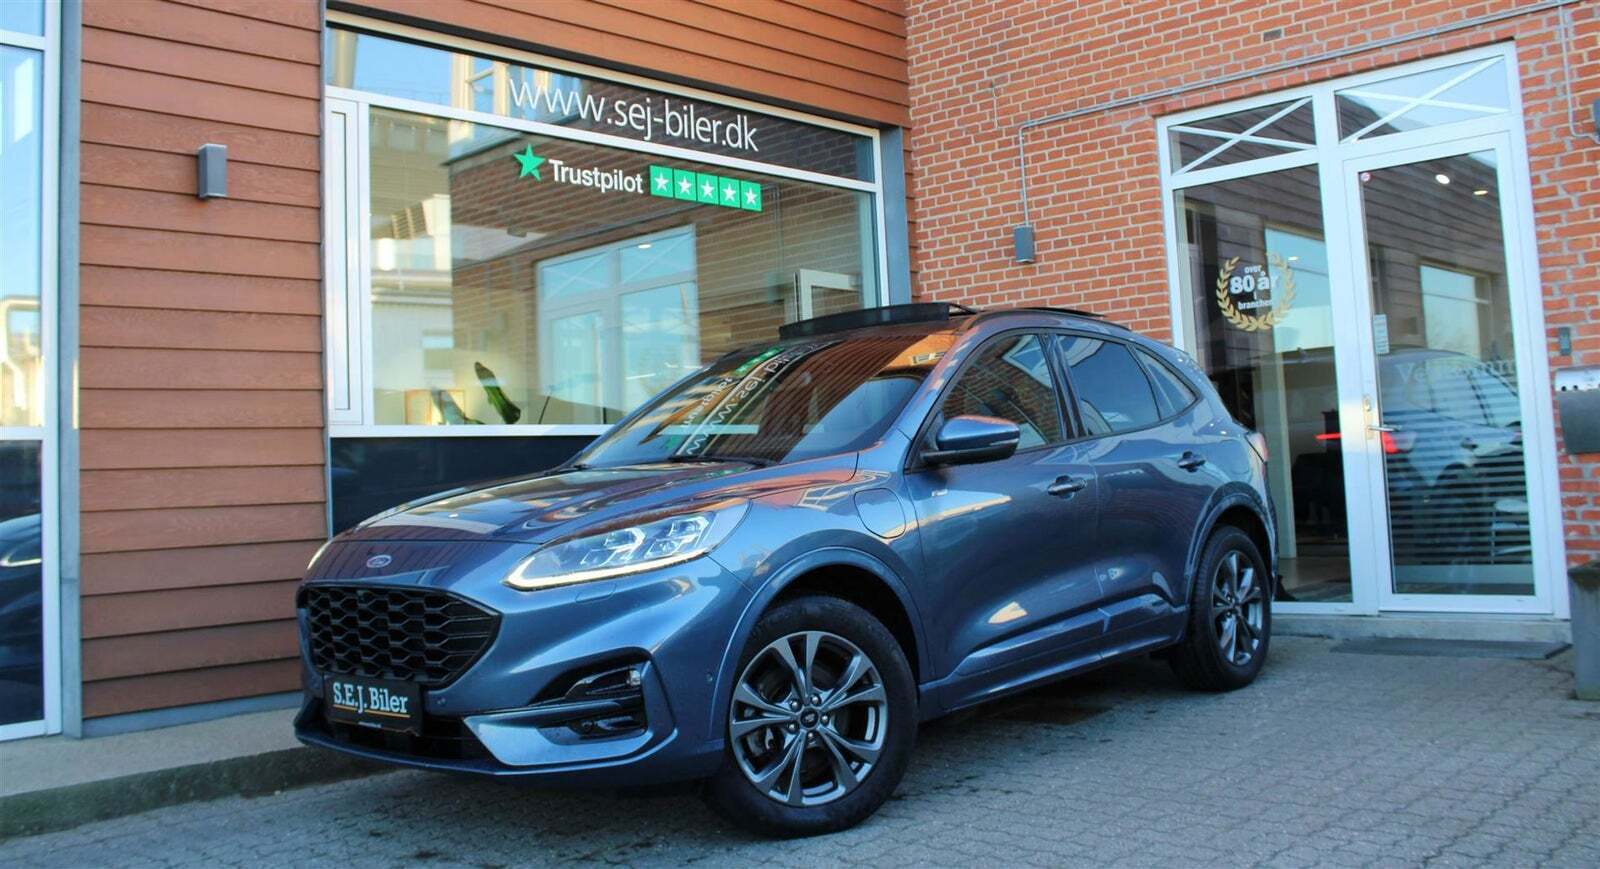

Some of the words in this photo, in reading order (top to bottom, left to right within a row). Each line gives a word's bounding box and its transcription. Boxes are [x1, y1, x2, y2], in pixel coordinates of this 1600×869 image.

[509, 79, 759, 151] www.sej-biler.dk
[548, 159, 644, 194] Trustpilot
[1229, 275, 1255, 294] 80
[1257, 271, 1279, 290] år
[333, 682, 368, 713] S.E.J.
[369, 687, 408, 713] Biler
